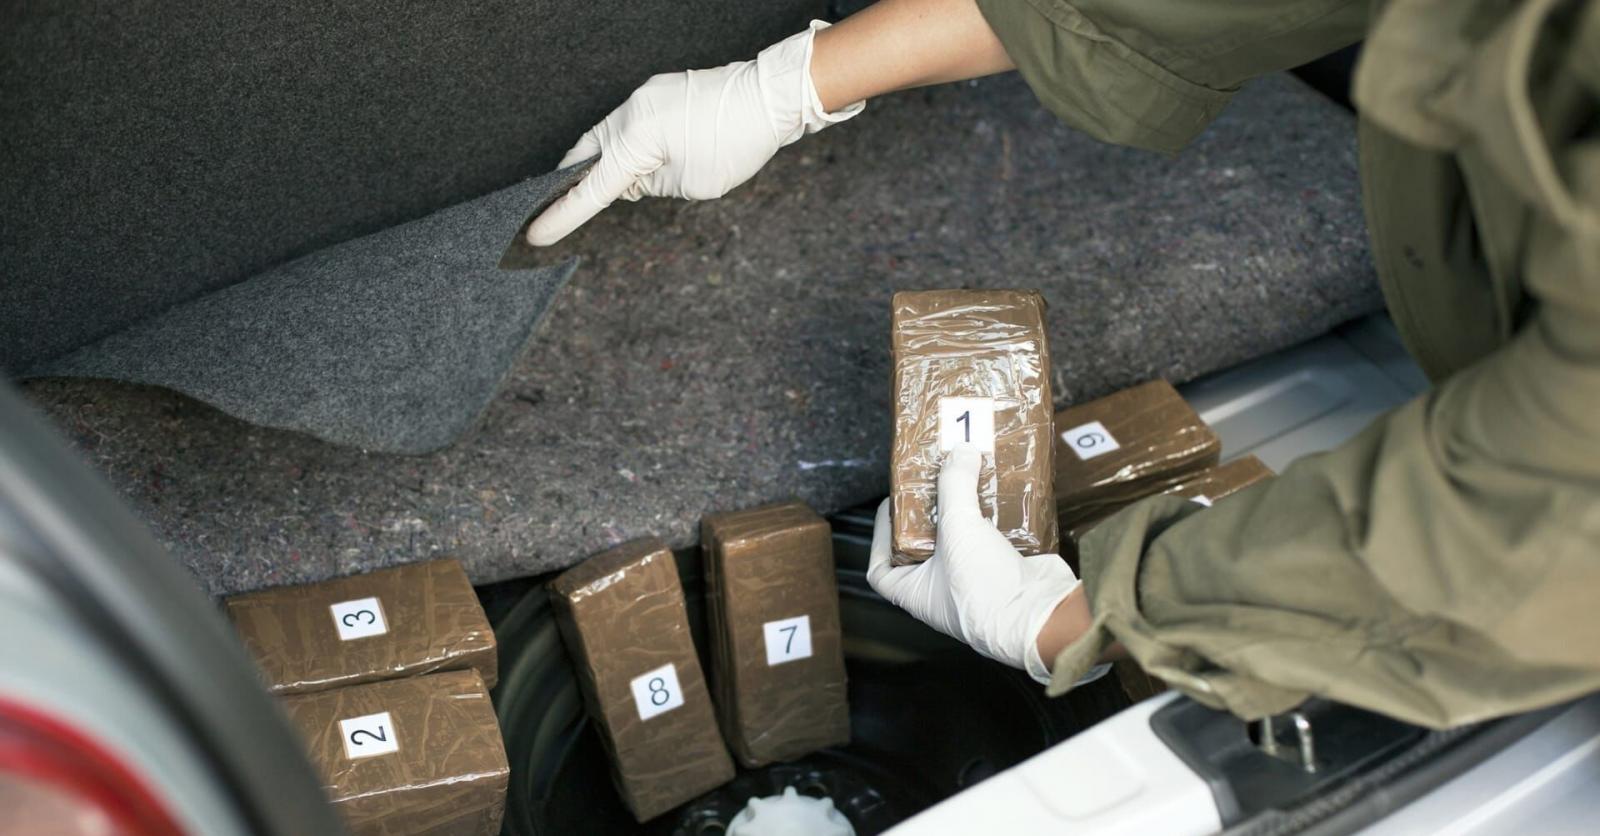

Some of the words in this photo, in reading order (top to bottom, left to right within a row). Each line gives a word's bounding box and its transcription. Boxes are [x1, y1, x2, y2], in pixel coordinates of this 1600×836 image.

[956, 410, 970, 443] 1
[342, 609, 376, 628] 3
[779, 625, 797, 654] 7
[648, 676, 670, 706] 8
[350, 725, 387, 746] 2
